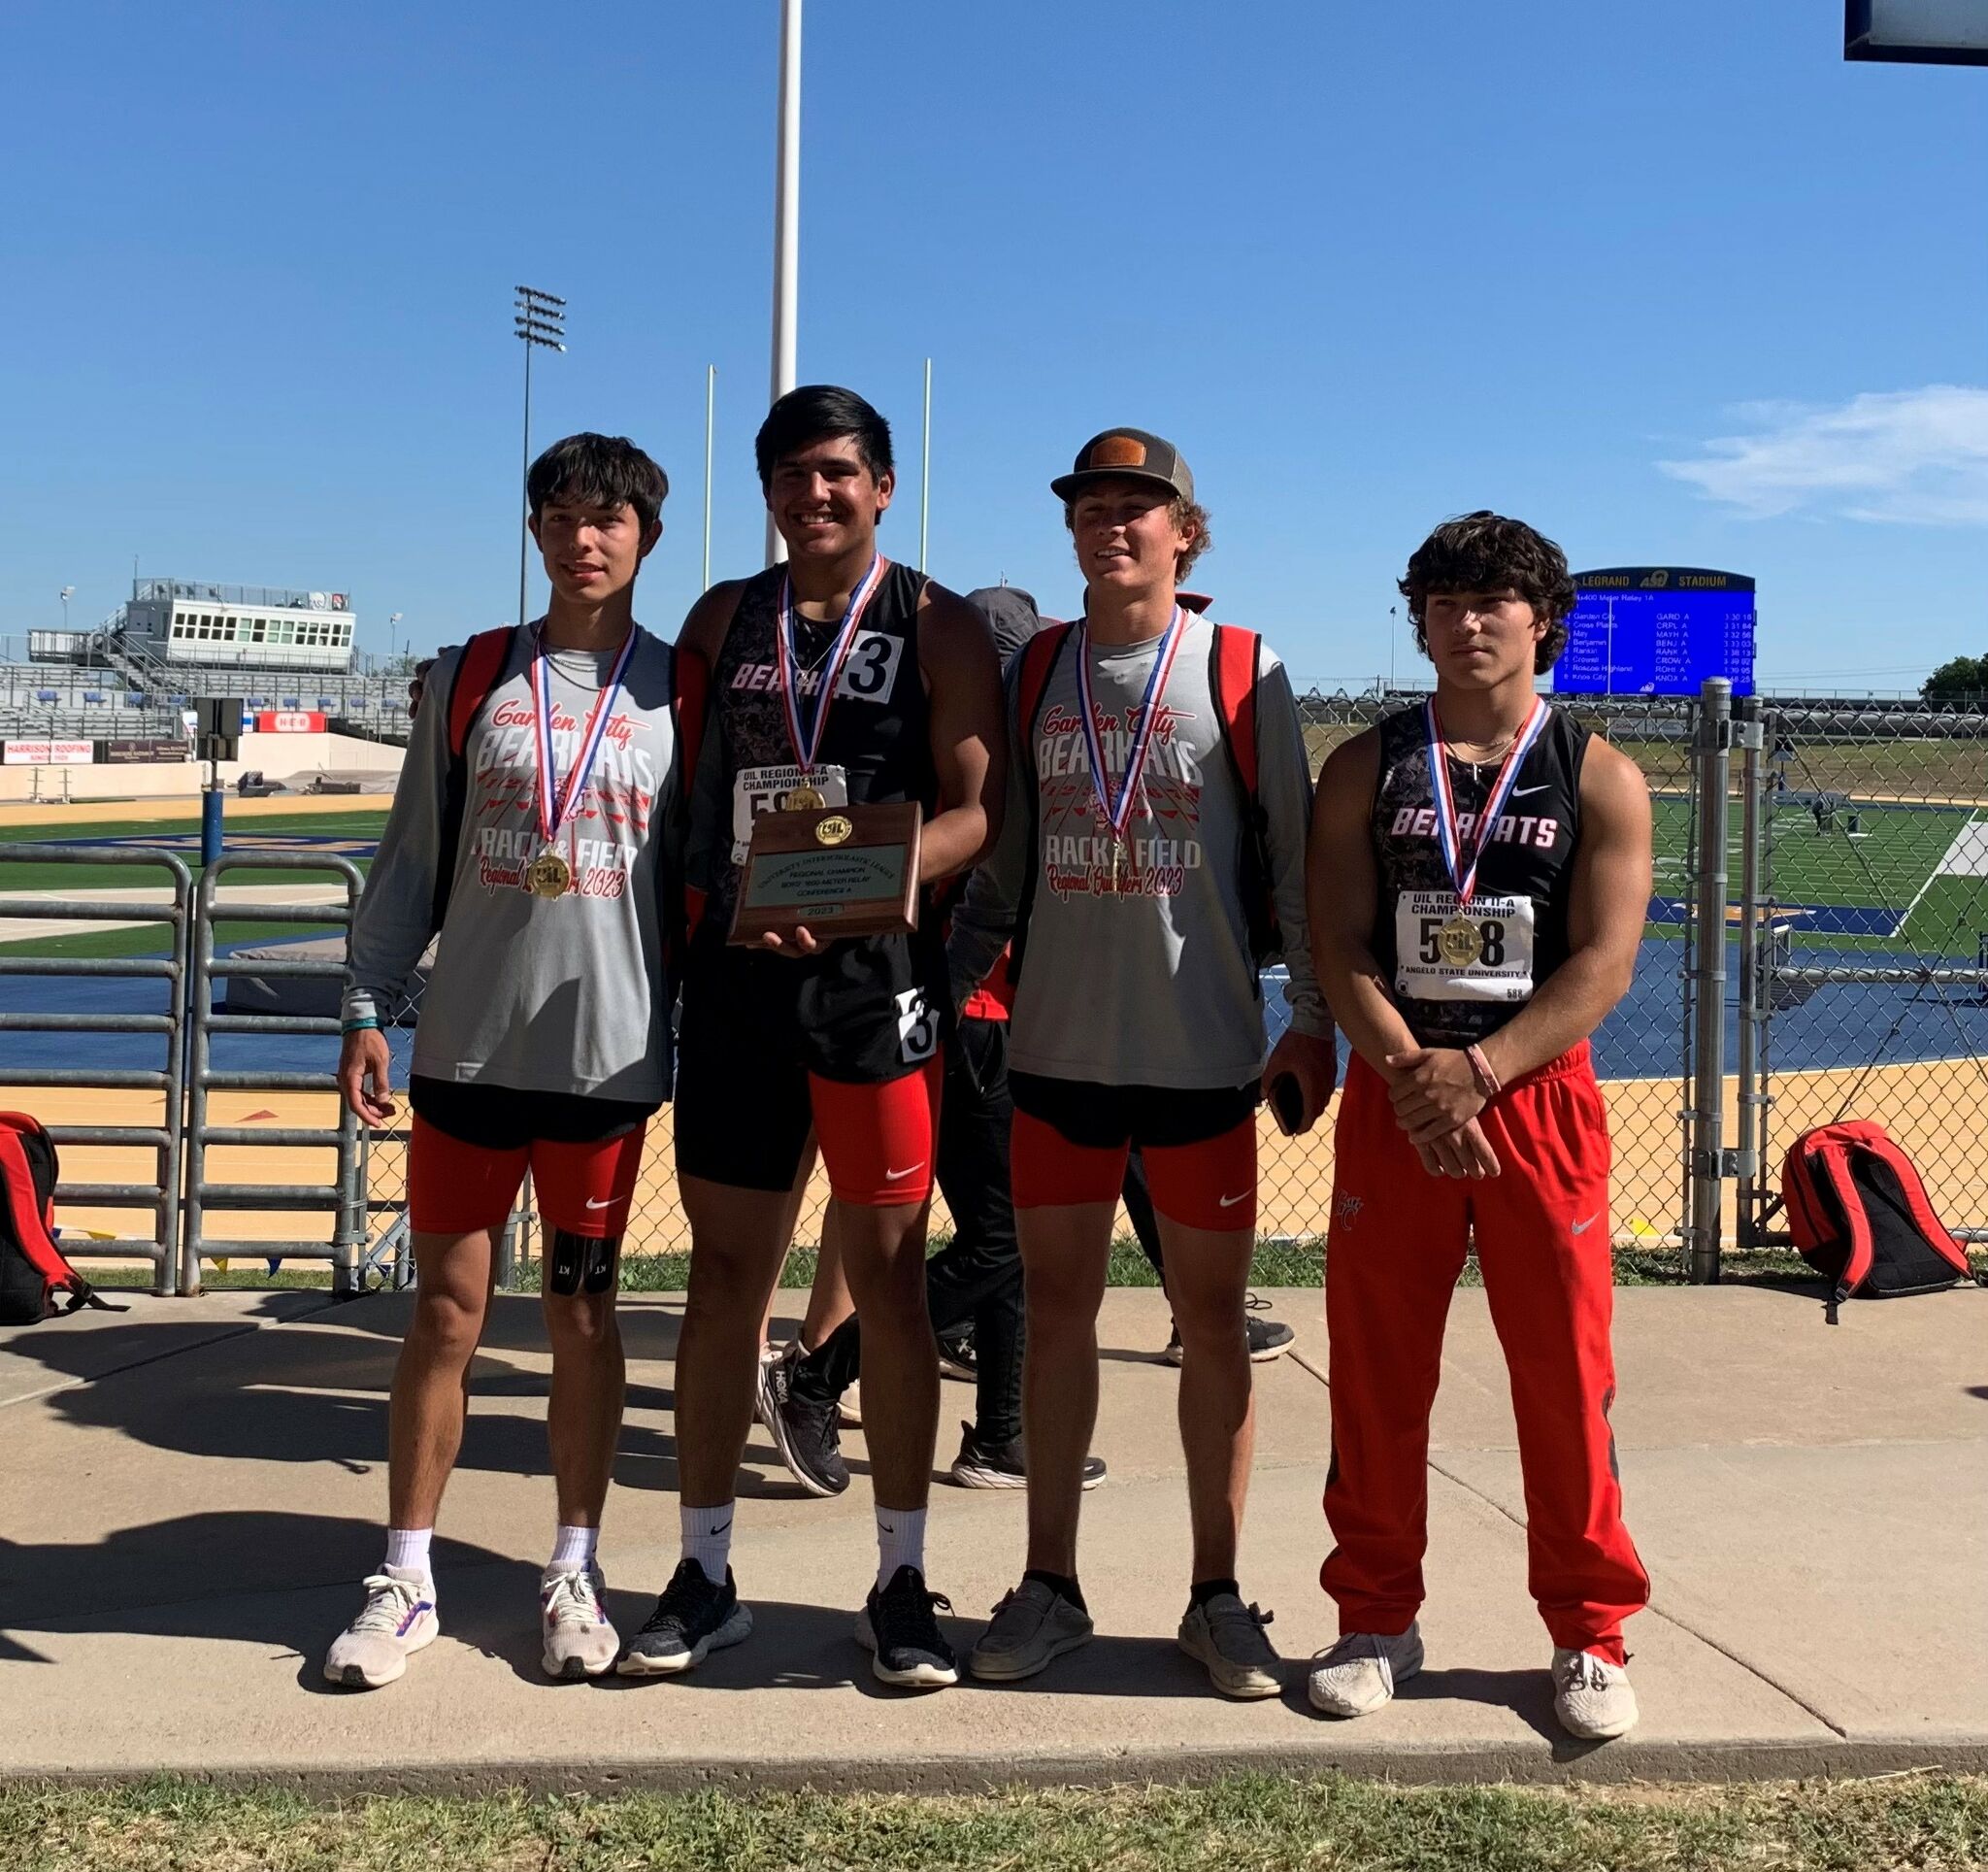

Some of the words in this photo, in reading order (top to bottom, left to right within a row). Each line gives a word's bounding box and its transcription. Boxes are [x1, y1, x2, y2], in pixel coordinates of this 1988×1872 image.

[1582, 575, 1630, 587] LEGRAND
[1678, 576, 1727, 587] STADIUM
[1602, 612, 1616, 621] Cy
[847, 636, 893, 694] 3
[1601, 665, 1634, 674] Hghland
[7, 745, 51, 753] HARRISON
[54, 745, 92, 753] ROOFING
[744, 770, 759, 781] UIL
[1136, 838, 1202, 869] FIELD
[582, 867, 626, 898] 2023
[1046, 863, 1092, 903] Regional
[1144, 866, 1184, 896] 2023
[1413, 893, 1432, 904] UIL
[807, 907, 834, 917] 2023
[1411, 904, 1516, 919] CHAMPONSHIP
[1419, 918, 1505, 967] 58
[1406, 966, 1436, 975] ANGELO
[1439, 968, 1466, 977] STATE
[776, 1370, 789, 1404] HOKA
